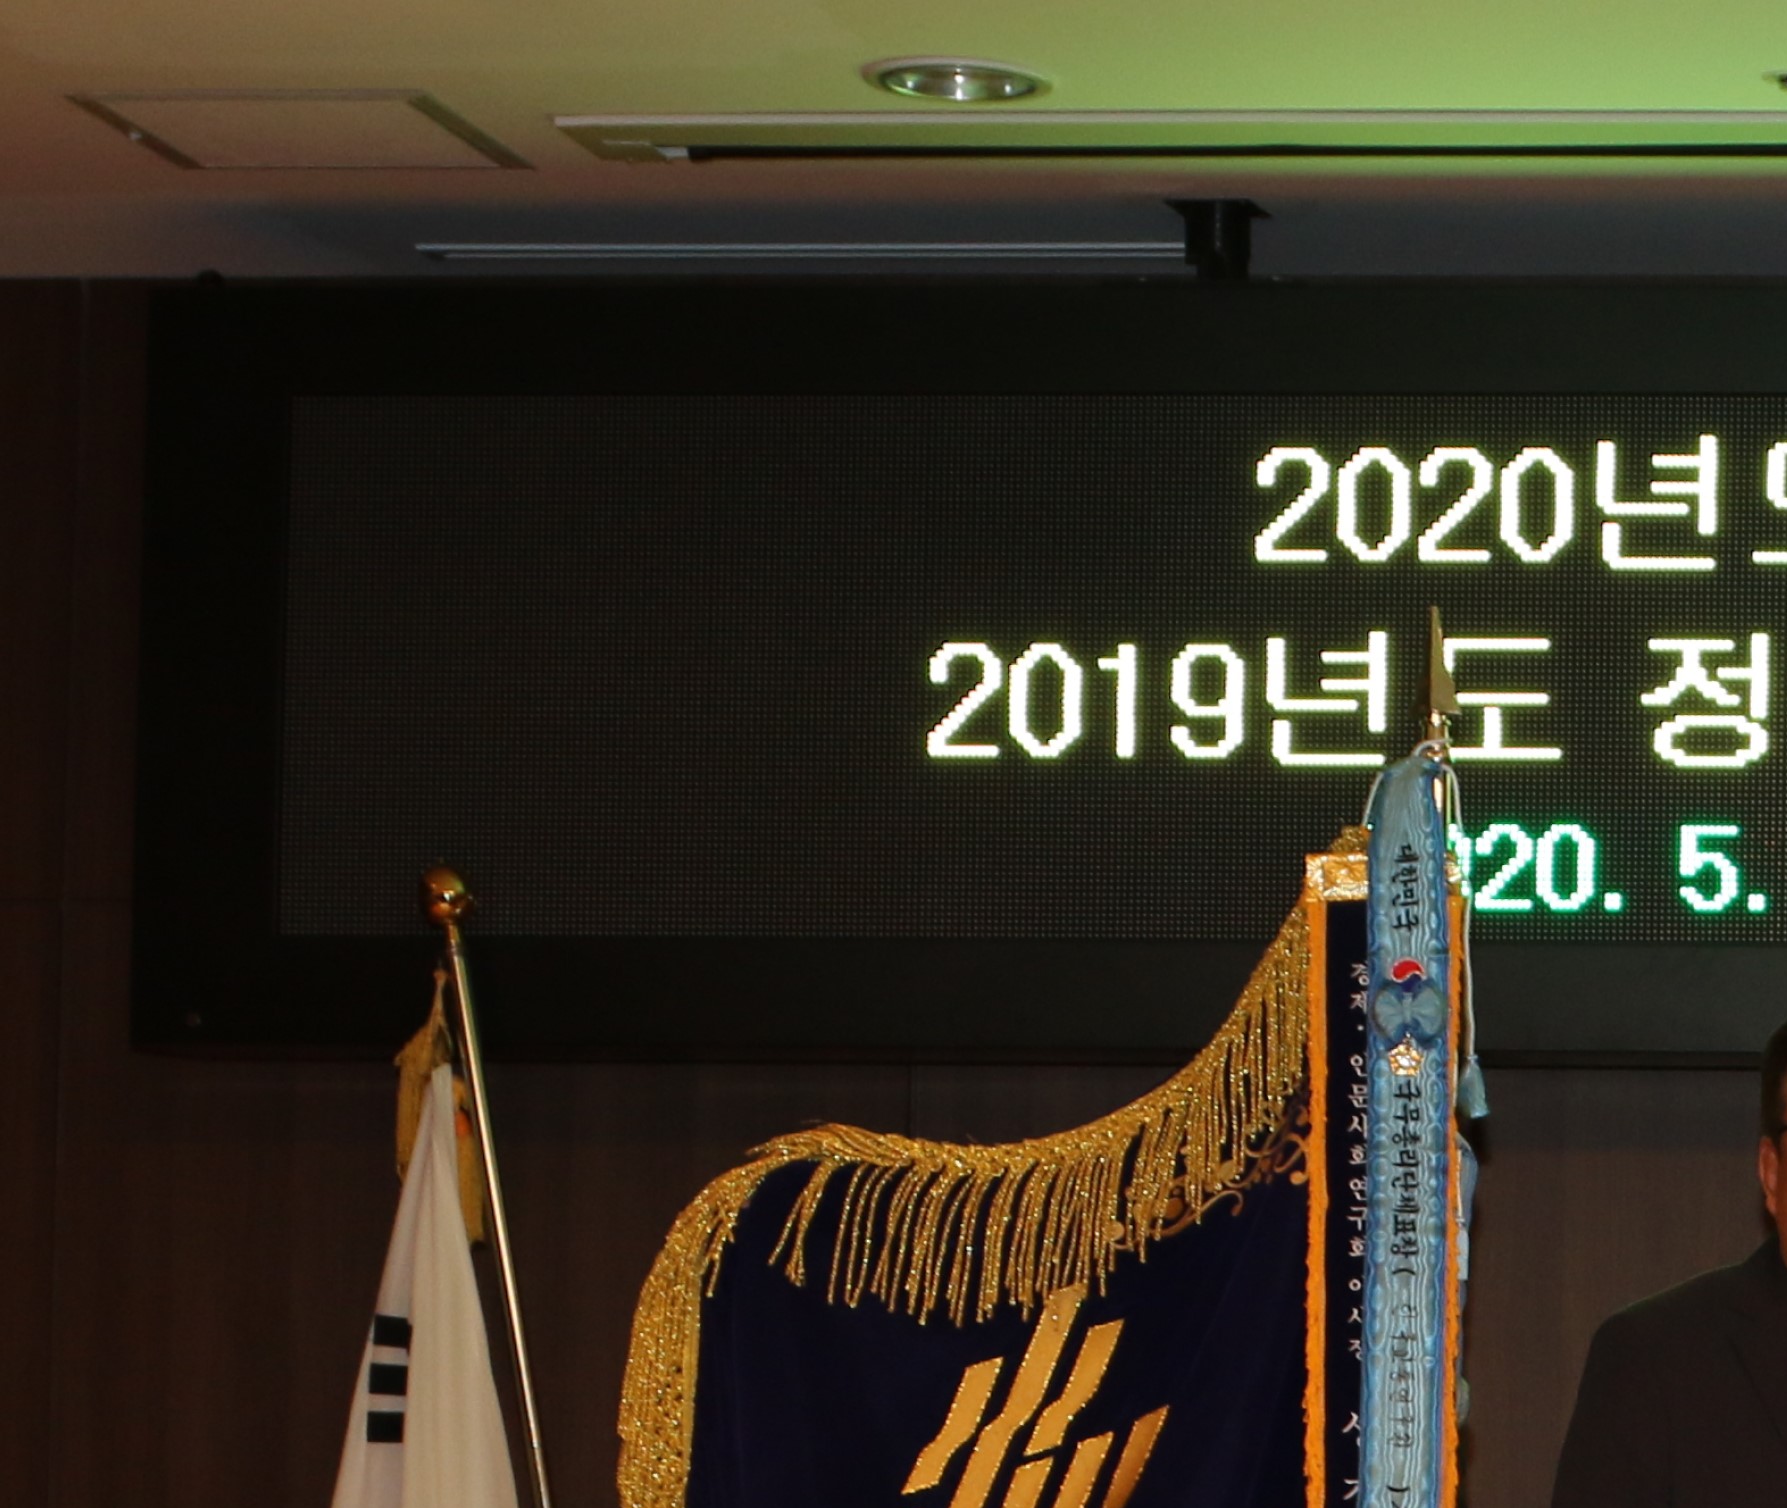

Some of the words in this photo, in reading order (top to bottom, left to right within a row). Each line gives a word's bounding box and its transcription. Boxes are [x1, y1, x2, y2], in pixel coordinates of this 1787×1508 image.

[926, 629, 1564, 768] 2019년도
[1393, 843, 1420, 932] 대한민국
[1447, 822, 1624, 912] 20.
[1677, 823, 1768, 914] 5.
